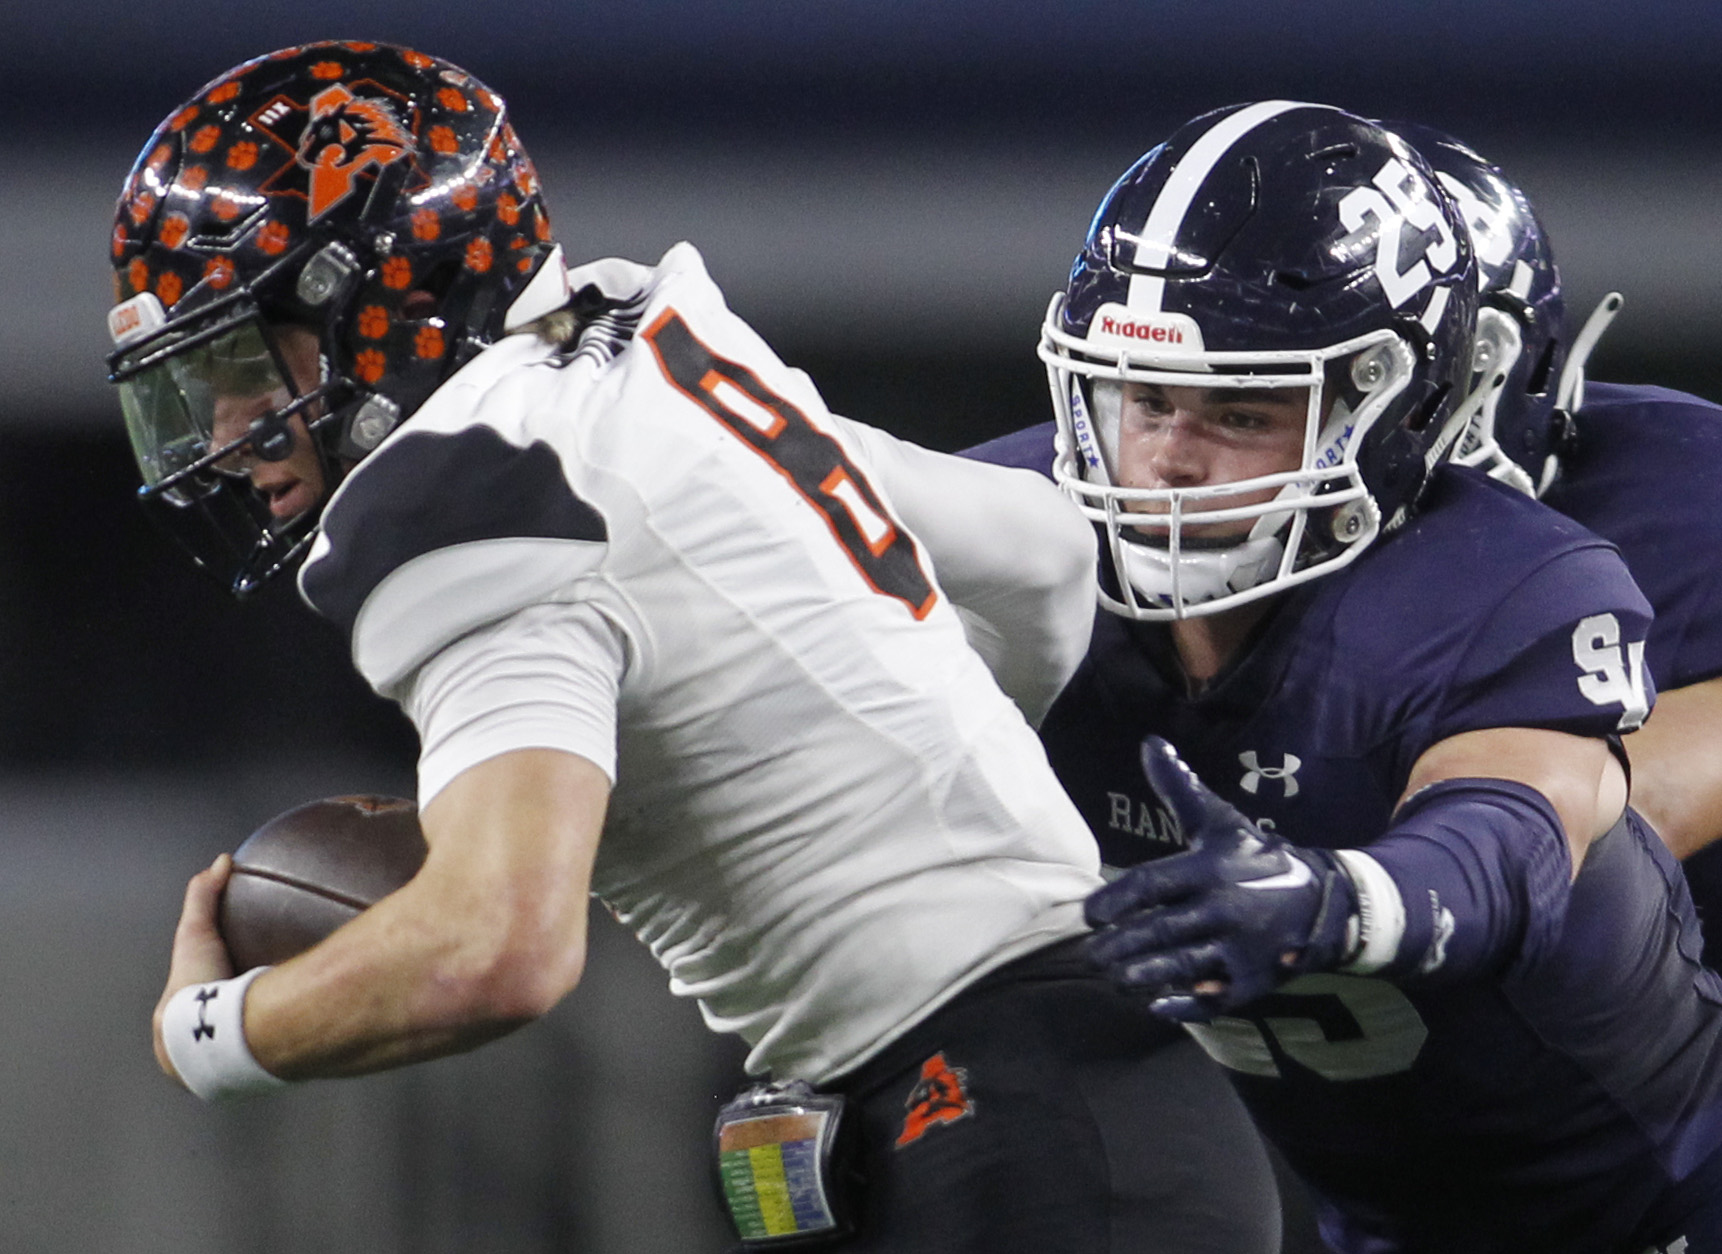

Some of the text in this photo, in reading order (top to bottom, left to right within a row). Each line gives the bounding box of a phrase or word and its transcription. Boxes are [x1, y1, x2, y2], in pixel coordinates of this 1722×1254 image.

[1338, 157, 1457, 309] 25
[1101, 316, 1183, 344] Riddell
[640, 306, 938, 621] 8
[1072, 394, 1094, 454] SPORT
